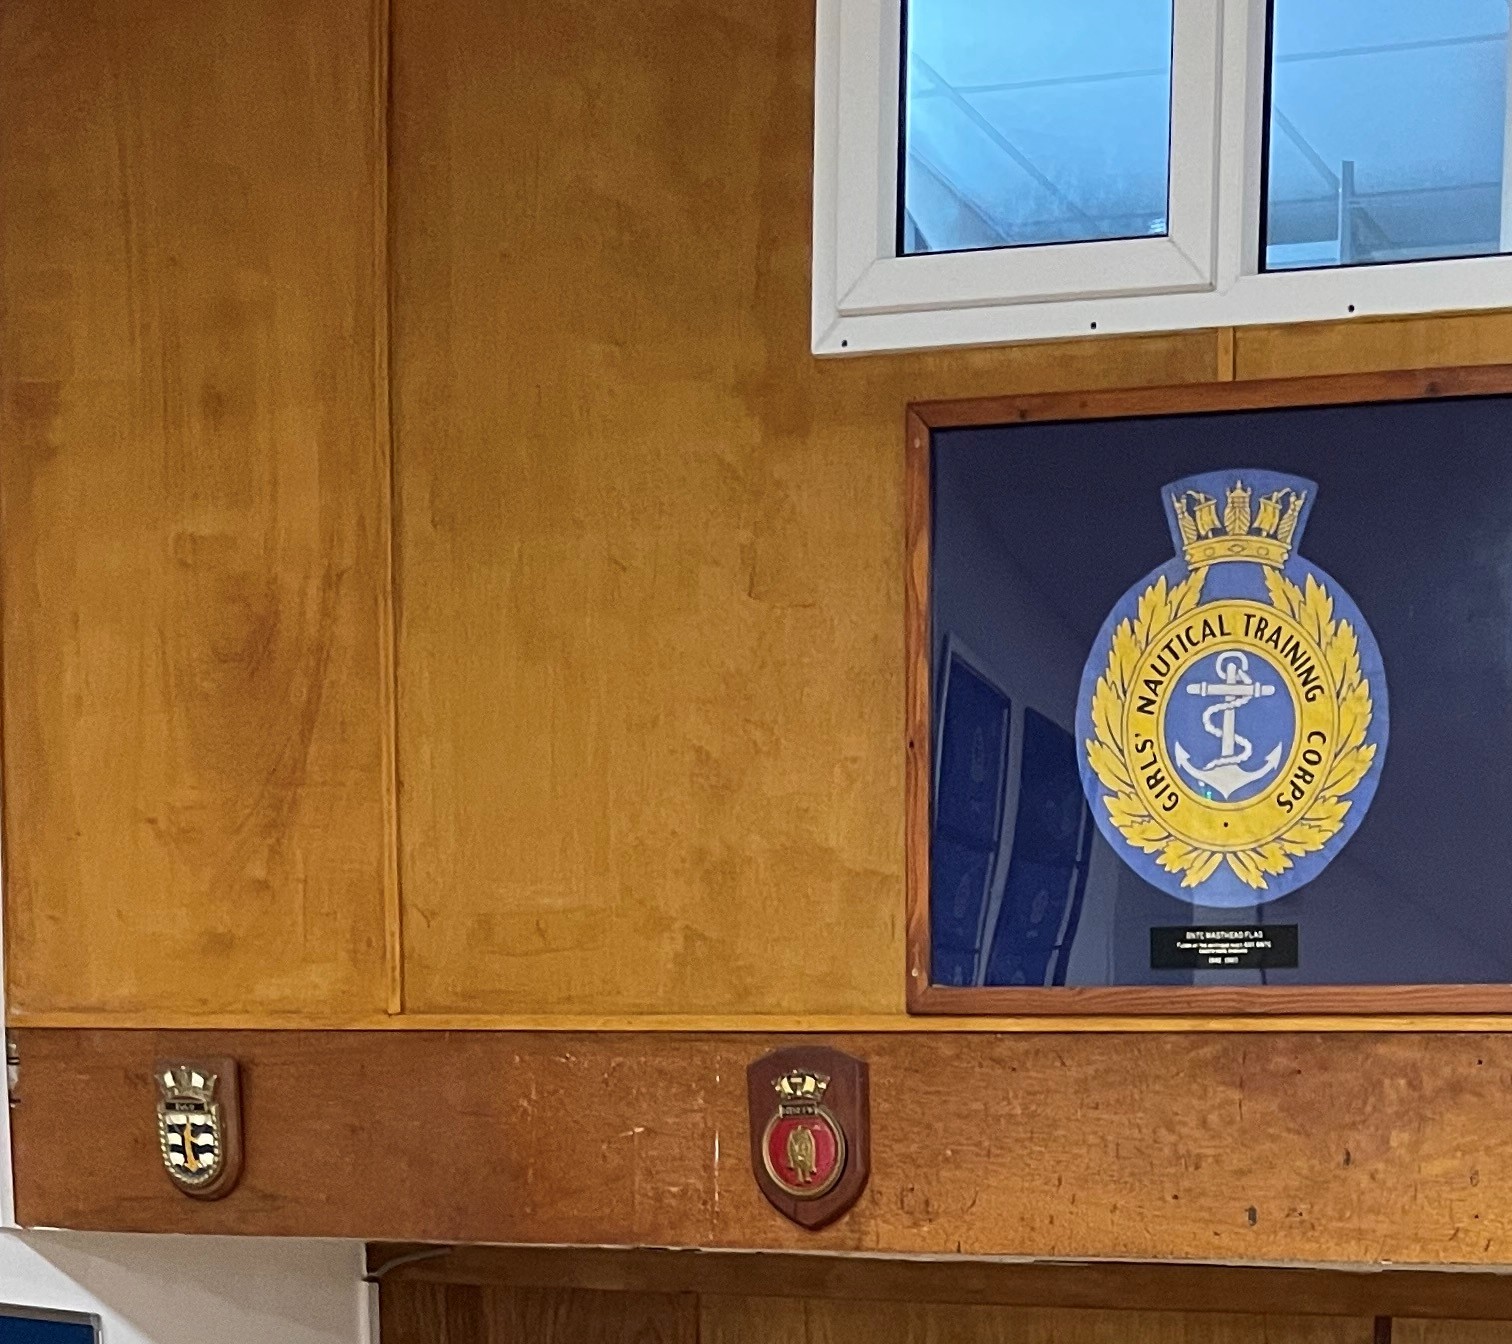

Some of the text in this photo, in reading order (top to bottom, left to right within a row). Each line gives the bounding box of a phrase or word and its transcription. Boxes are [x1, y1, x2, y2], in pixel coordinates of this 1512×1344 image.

[1134, 613, 1327, 814] GIRLS' NAUTICAL TRAINING CORPS
